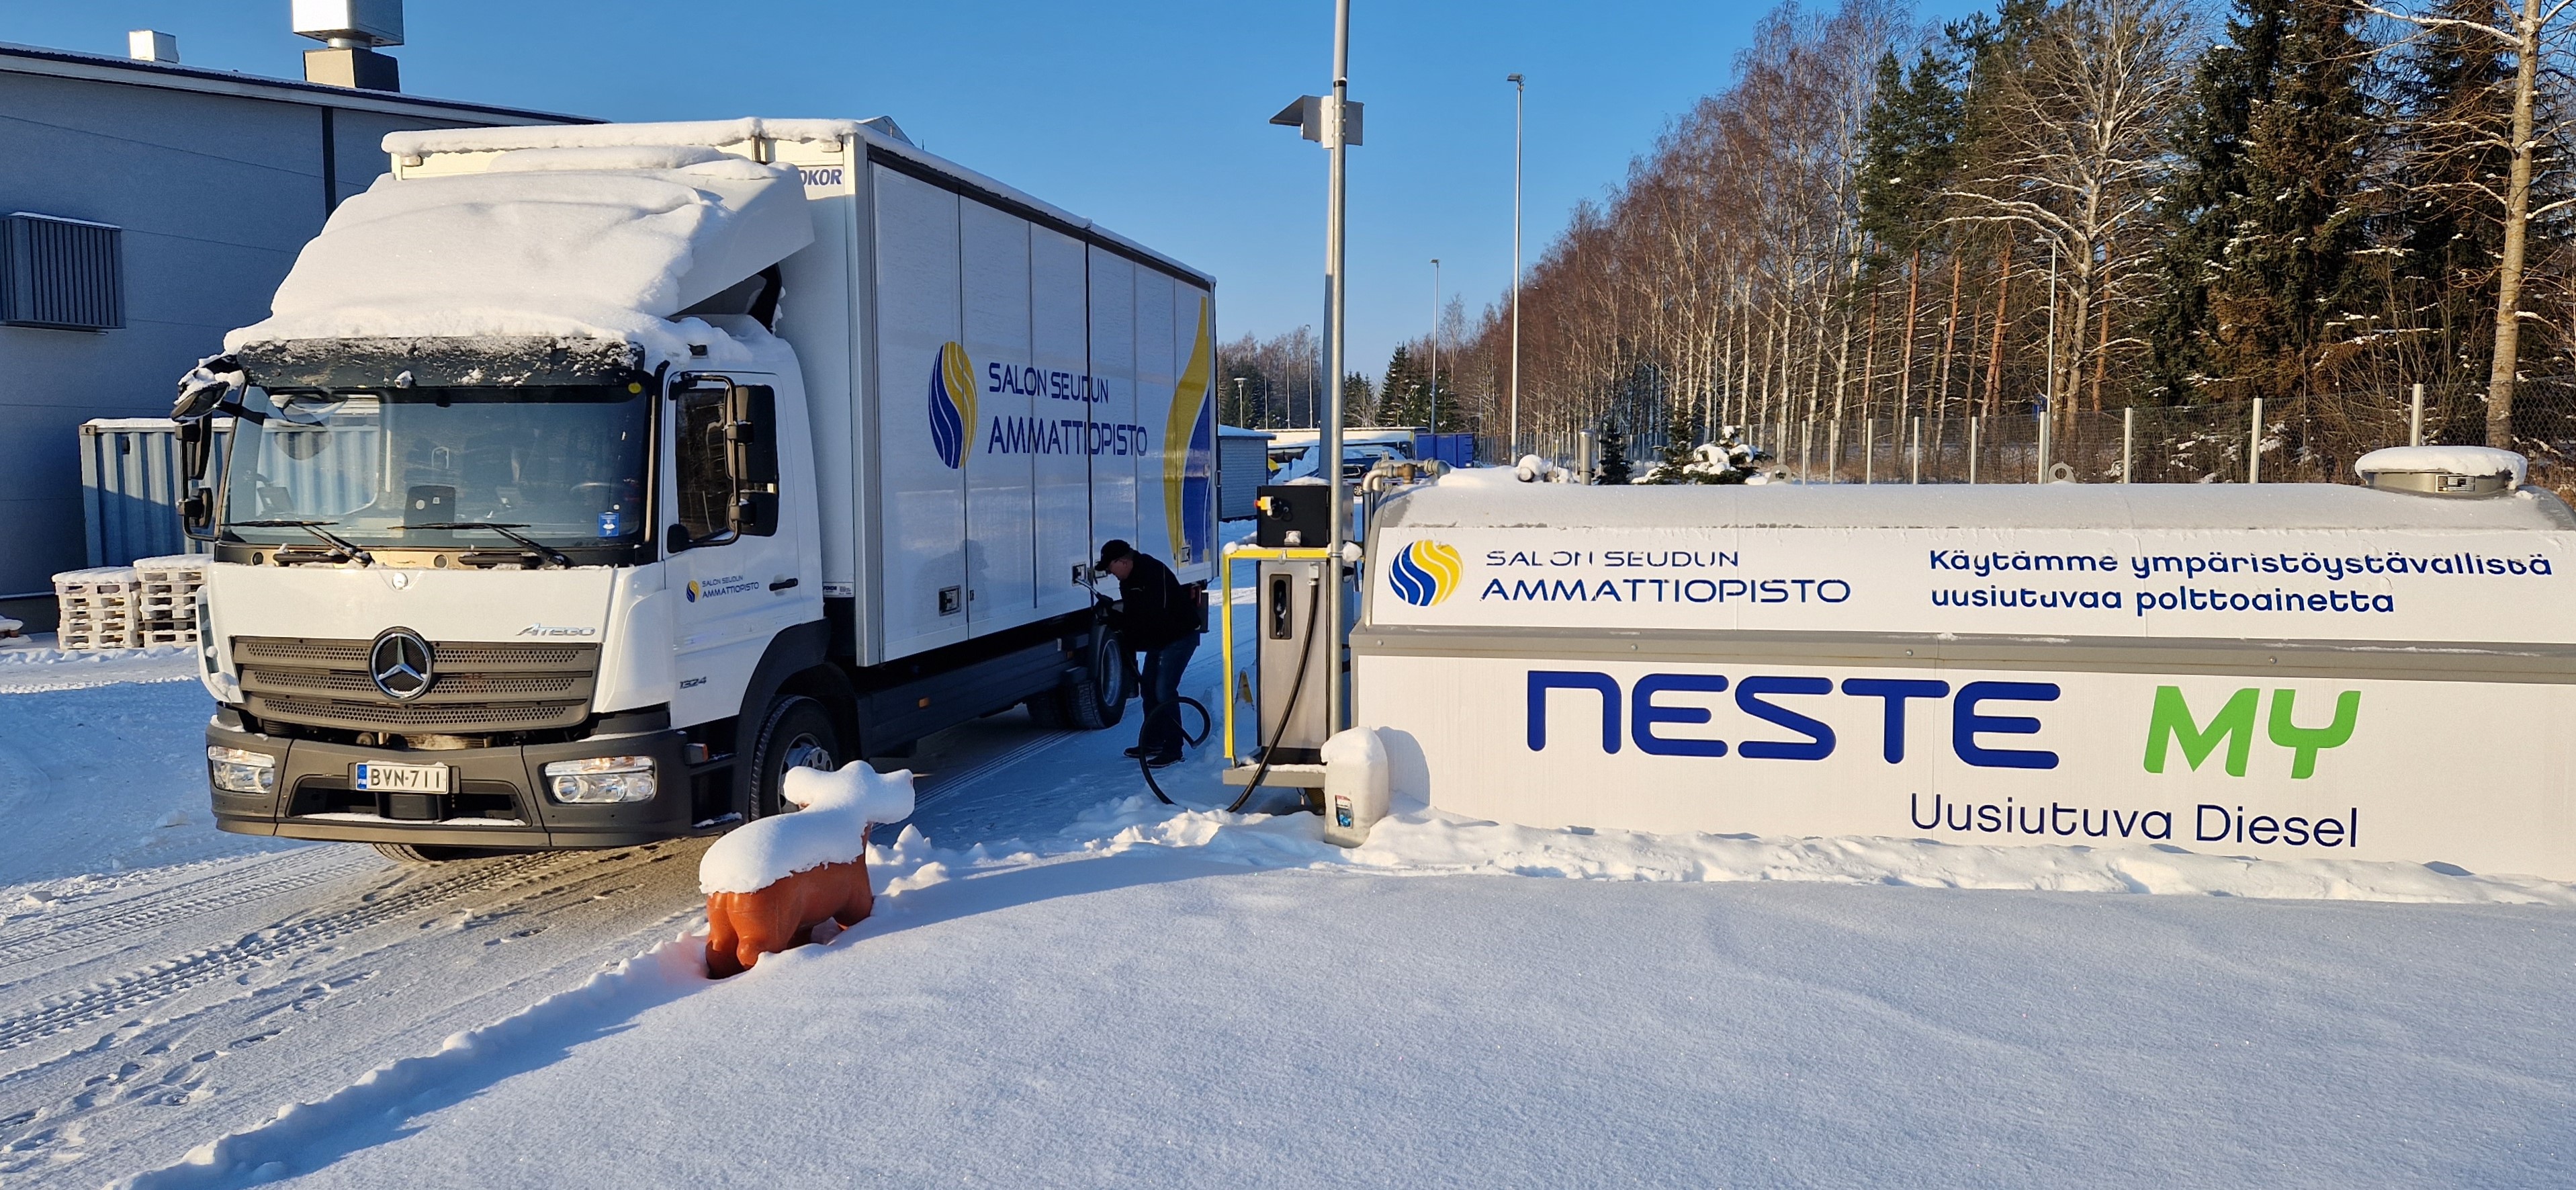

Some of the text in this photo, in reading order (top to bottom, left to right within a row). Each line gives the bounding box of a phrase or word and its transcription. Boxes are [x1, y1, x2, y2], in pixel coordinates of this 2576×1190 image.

[989, 362, 1109, 404] SALON SEUDUN
[988, 415, 1148, 456] AMMATTIOPISTO
[1486, 550, 1739, 567] SALON SEUDUN
[1930, 549, 2119, 577] Käytämme
[702, 579, 721, 587] SALON
[703, 582, 759, 599] AMMATTIOPISTO
[1480, 578, 1851, 603] AMMATTIOPISTO
[1931, 585, 2395, 617] uusiutuvaa polttoainetta
[680, 676, 707, 689] 1324
[2143, 686, 2361, 779] MY
[371, 769, 440, 788] BVN-711
[1911, 793, 2357, 848] Uusiutuva Diesel
